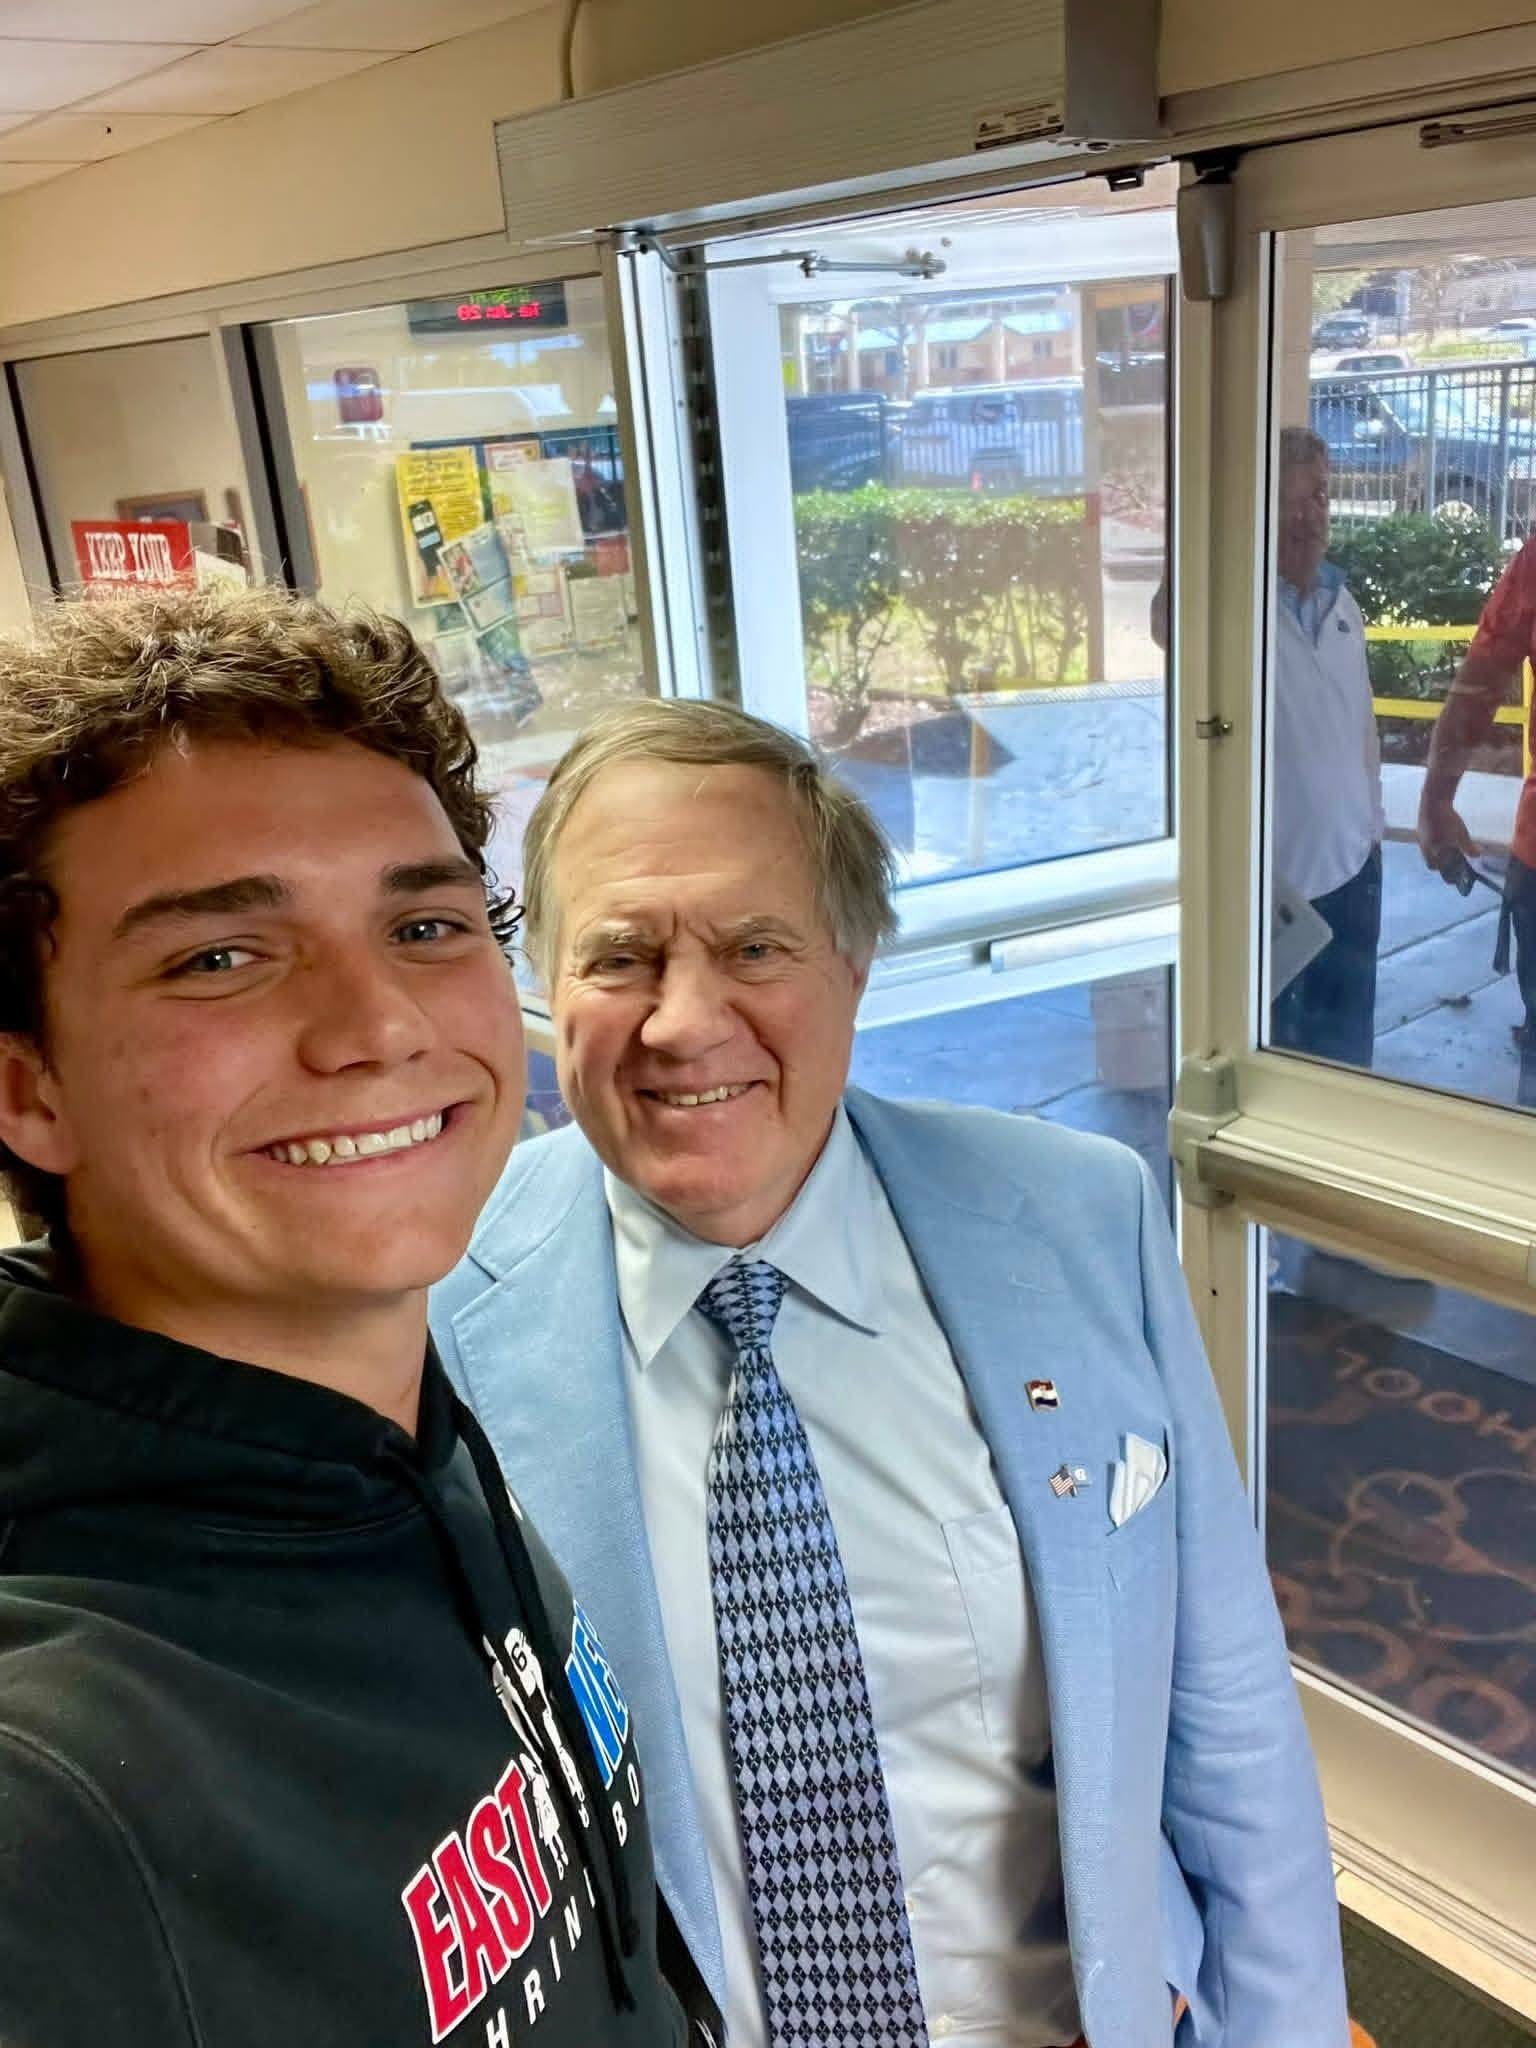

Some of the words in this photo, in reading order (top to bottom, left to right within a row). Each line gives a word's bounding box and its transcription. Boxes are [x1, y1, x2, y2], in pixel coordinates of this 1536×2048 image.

[84, 532, 128, 580] KEEP
[128, 533, 175, 583] YOUR
[612, 1738, 641, 1847] BO
[401, 1761, 552, 2044] EAST
